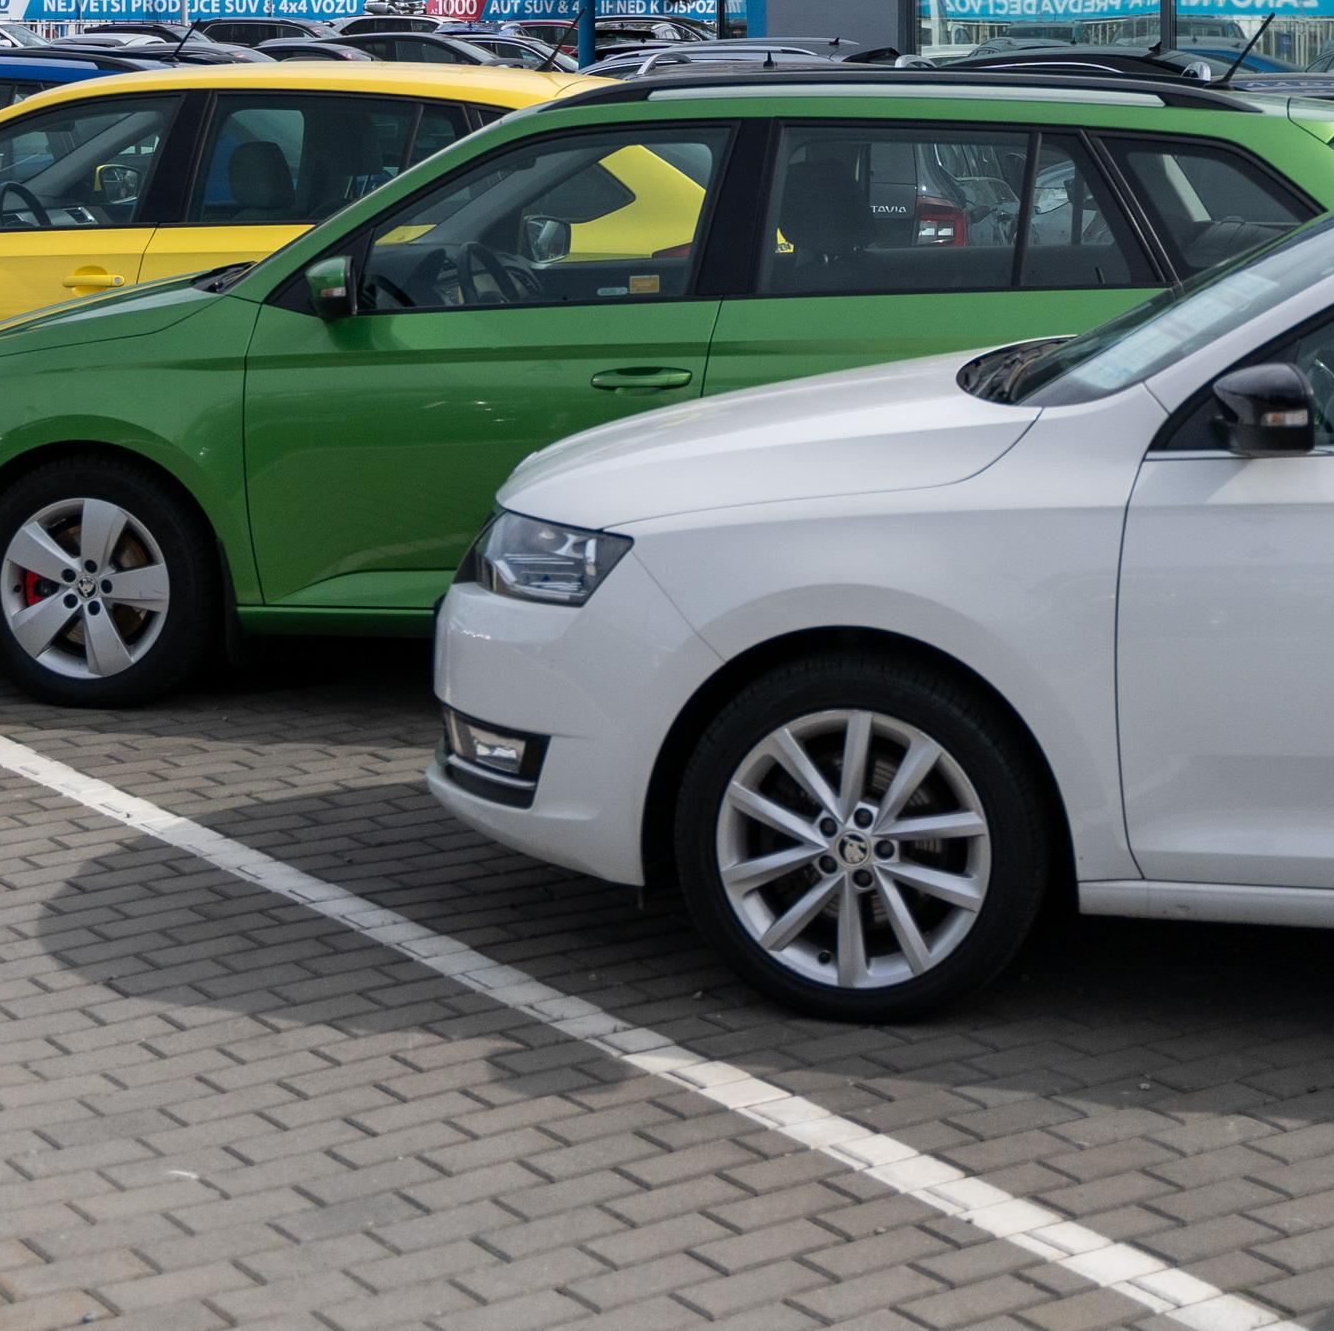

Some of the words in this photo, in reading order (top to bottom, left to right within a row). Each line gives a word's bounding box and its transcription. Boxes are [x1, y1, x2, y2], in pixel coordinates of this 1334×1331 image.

[279, 0, 308, 13] 4x4
[490, 0, 521, 13] AUT
[525, 0, 554, 13] SUV
[558, 0, 568, 13] &
[601, 0, 646, 13] IHNED
[650, 0, 659, 13] K
[664, 0, 716, 13] DISPOZ
[870, 205, 907, 213] TAVIA
